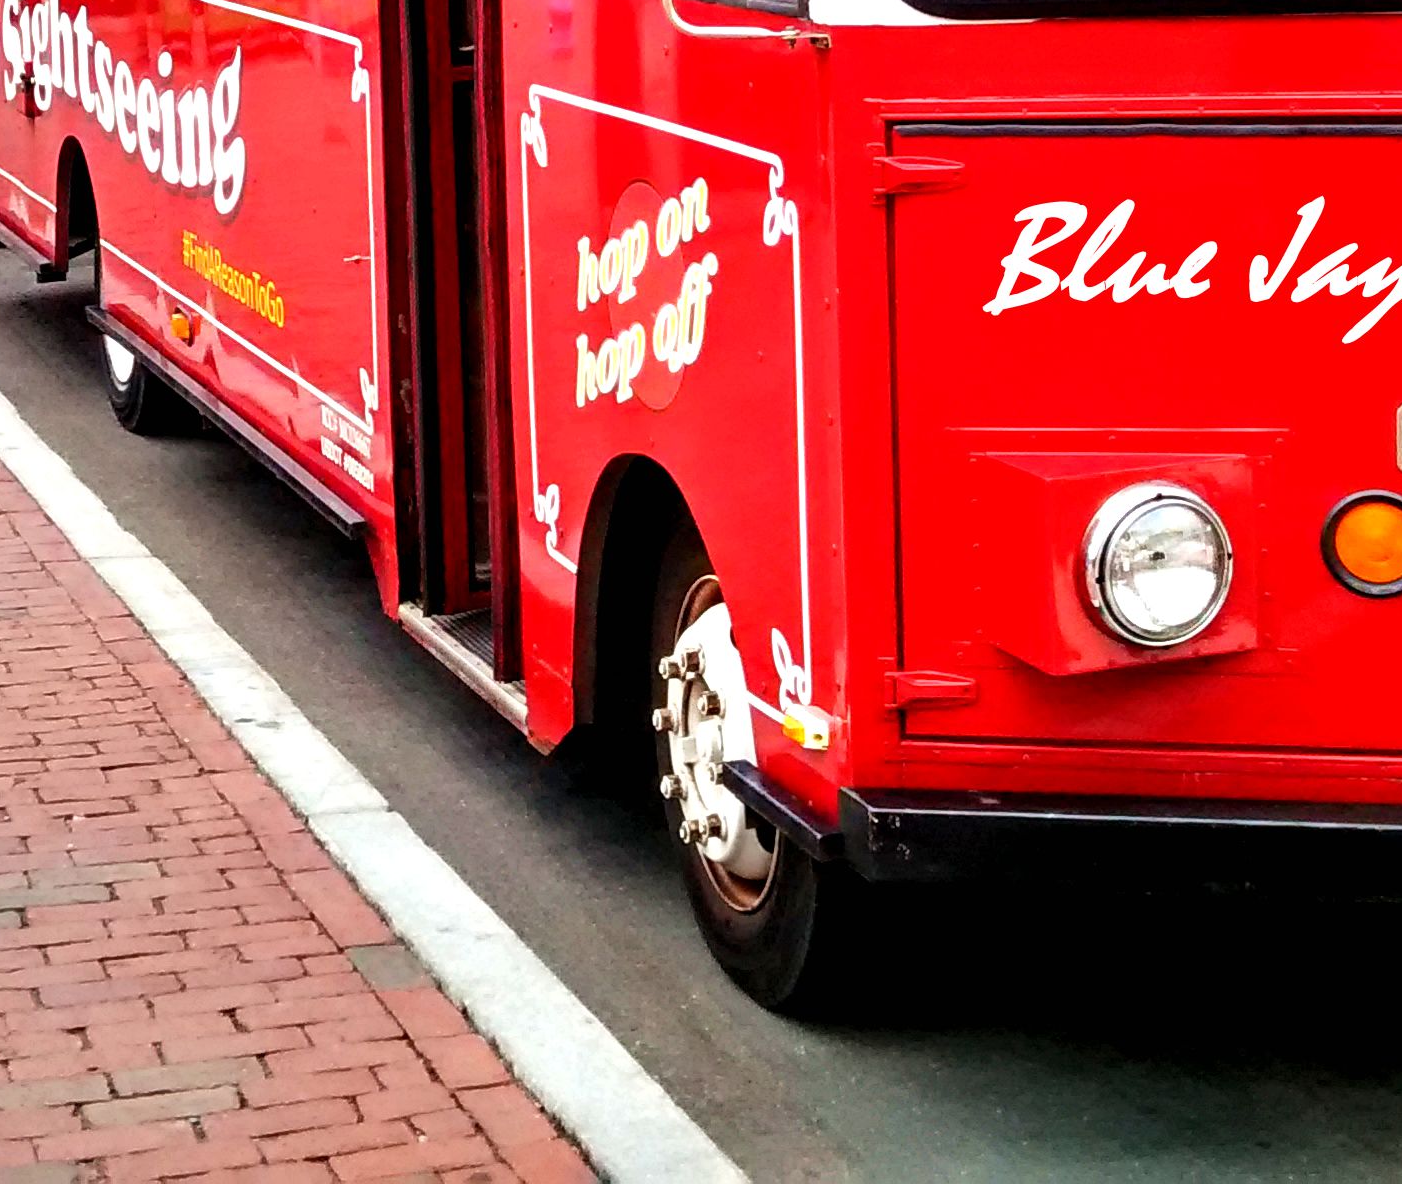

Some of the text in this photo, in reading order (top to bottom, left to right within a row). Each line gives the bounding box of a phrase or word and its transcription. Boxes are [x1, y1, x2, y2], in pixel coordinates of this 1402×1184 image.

[182, 229, 285, 330] #FindAReasonToGo
[575, 175, 711, 314] hop on
[983, 198, 1219, 317] Blue
[574, 251, 718, 409] hop off
